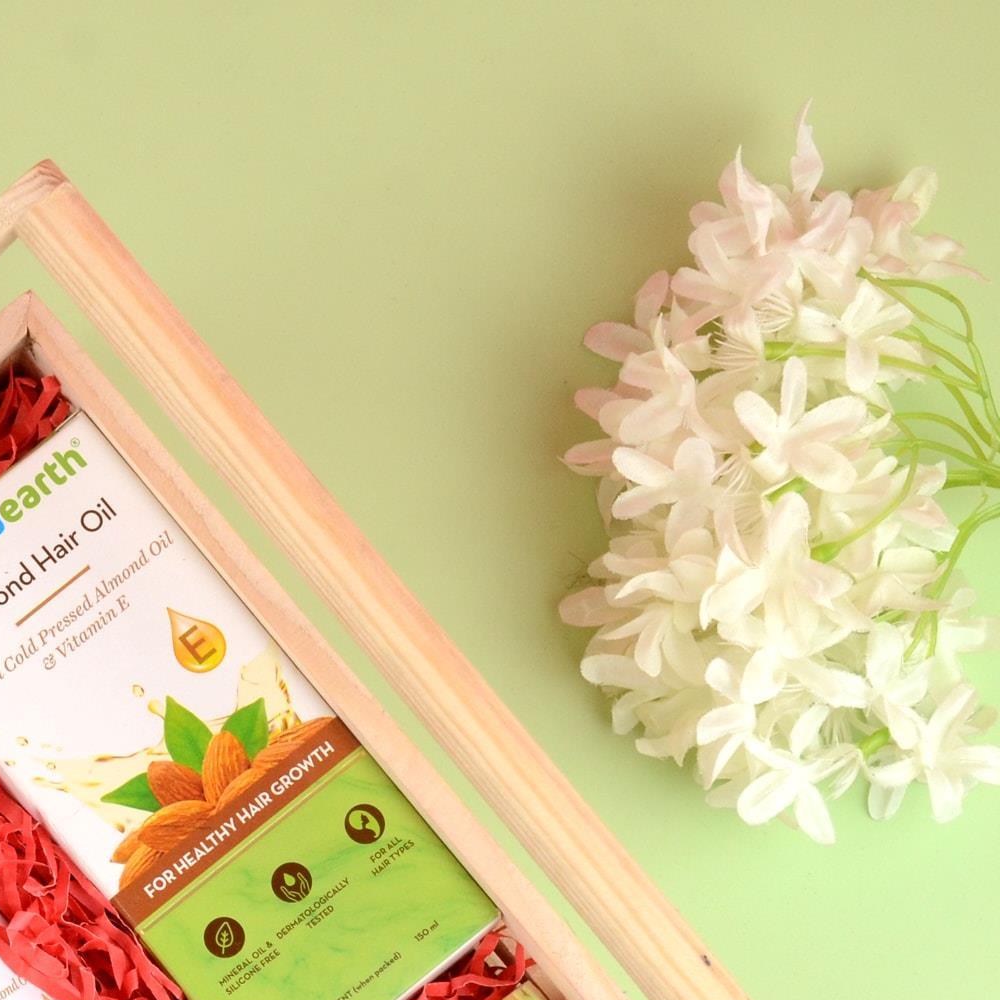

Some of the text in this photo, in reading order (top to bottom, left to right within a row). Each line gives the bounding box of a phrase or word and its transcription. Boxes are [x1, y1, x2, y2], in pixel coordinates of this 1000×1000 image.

[31, 531, 79, 572] Hair
[80, 497, 117, 533] Oil
[4, 638, 39, 673] Cold
[35, 594, 93, 647] Pressed
[92, 552, 149, 601] Almond
[149, 531, 174, 557] Oil
[43, 594, 130, 671] & Vitamin E
[179, 625, 216, 664] E
[143, 741, 335, 898] FOR HEALTHY HAIR GROWTH
[370, 836, 402, 863] FOR ALL
[371, 839, 415, 877] HAIR TYPES
[276, 877, 350, 940] DERMATOLOGICALLY
[306, 905, 334, 930] TESTED
[414, 920, 439, 942] 150 ml
[218, 958, 253, 986] MINERAL
[252, 947, 266, 959] OIL
[225, 949, 280, 995] SILICONE FREE
[353, 975, 374, 994] (when
[374, 951, 402, 977] packed)
